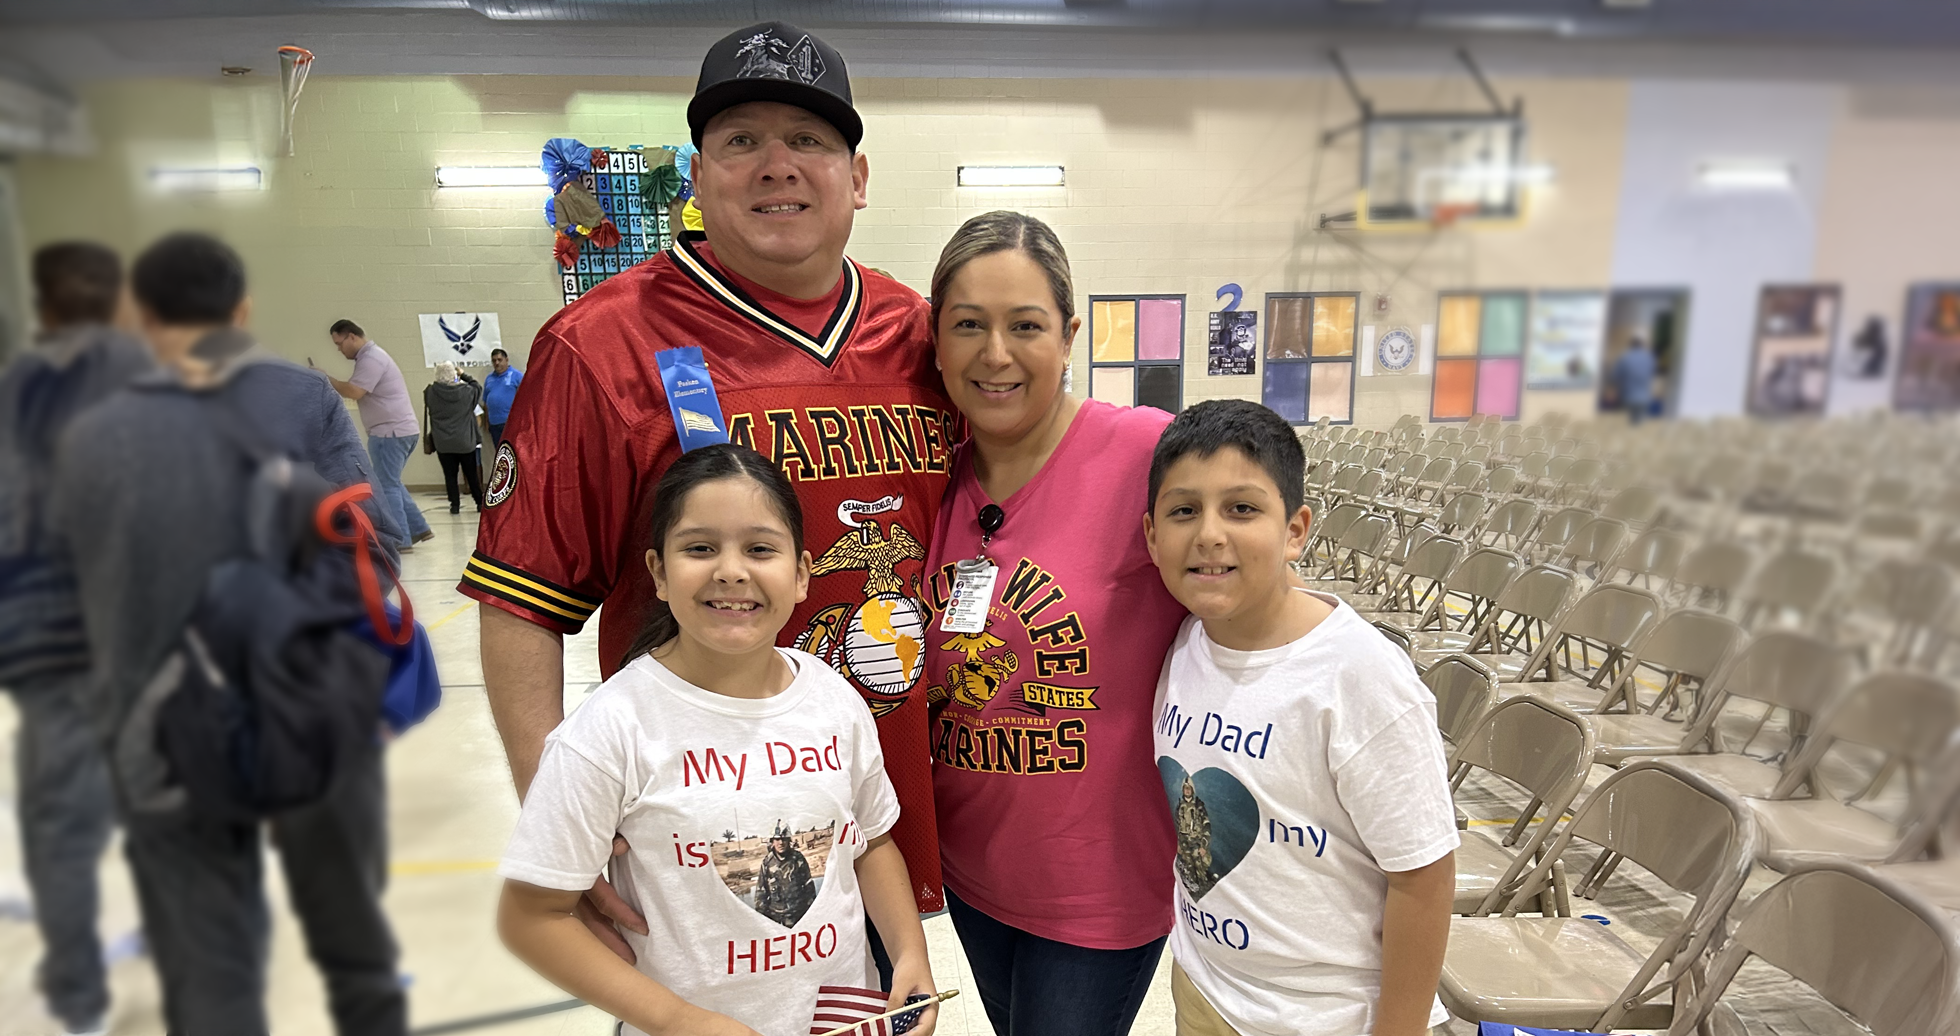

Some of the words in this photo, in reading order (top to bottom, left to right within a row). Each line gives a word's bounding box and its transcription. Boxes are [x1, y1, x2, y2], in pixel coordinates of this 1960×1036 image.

[613, 158, 620, 170] 4
[628, 158, 635, 170] 5
[586, 178, 593, 190] 2
[601, 177, 607, 189] 3
[615, 178, 622, 191] 4
[630, 179, 636, 191] 5
[603, 198, 609, 210] 6
[617, 199, 624, 211] 8
[629, 198, 640, 208] 10
[617, 219, 627, 228] 12
[631, 218, 641, 228] 15
[660, 219, 670, 228] 21
[620, 238, 630, 247] 16
[633, 238, 642, 247] 20
[580, 259, 587, 270] 5
[592, 258, 602, 267] 10
[606, 258, 616, 267] 15
[620, 257, 630, 267] 20
[567, 280, 573, 291] 6
[582, 280, 589, 291] 6
[842, 501, 871, 513] SEMPER
[871, 498, 892, 512] FIDELIS
[1000, 556, 1090, 678] WIFE
[1028, 685, 1085, 707] STATES
[992, 717, 1051, 726] COMMITMENT
[1158, 703, 1192, 748] My
[1199, 712, 1273, 759] Dad
[932, 718, 1088, 775] ARINES
[683, 748, 747, 791] My
[765, 735, 842, 776] Dad
[1270, 818, 1327, 857] my
[672, 833, 709, 868] is
[1181, 898, 1250, 950] HERO
[728, 923, 837, 975] HERO
